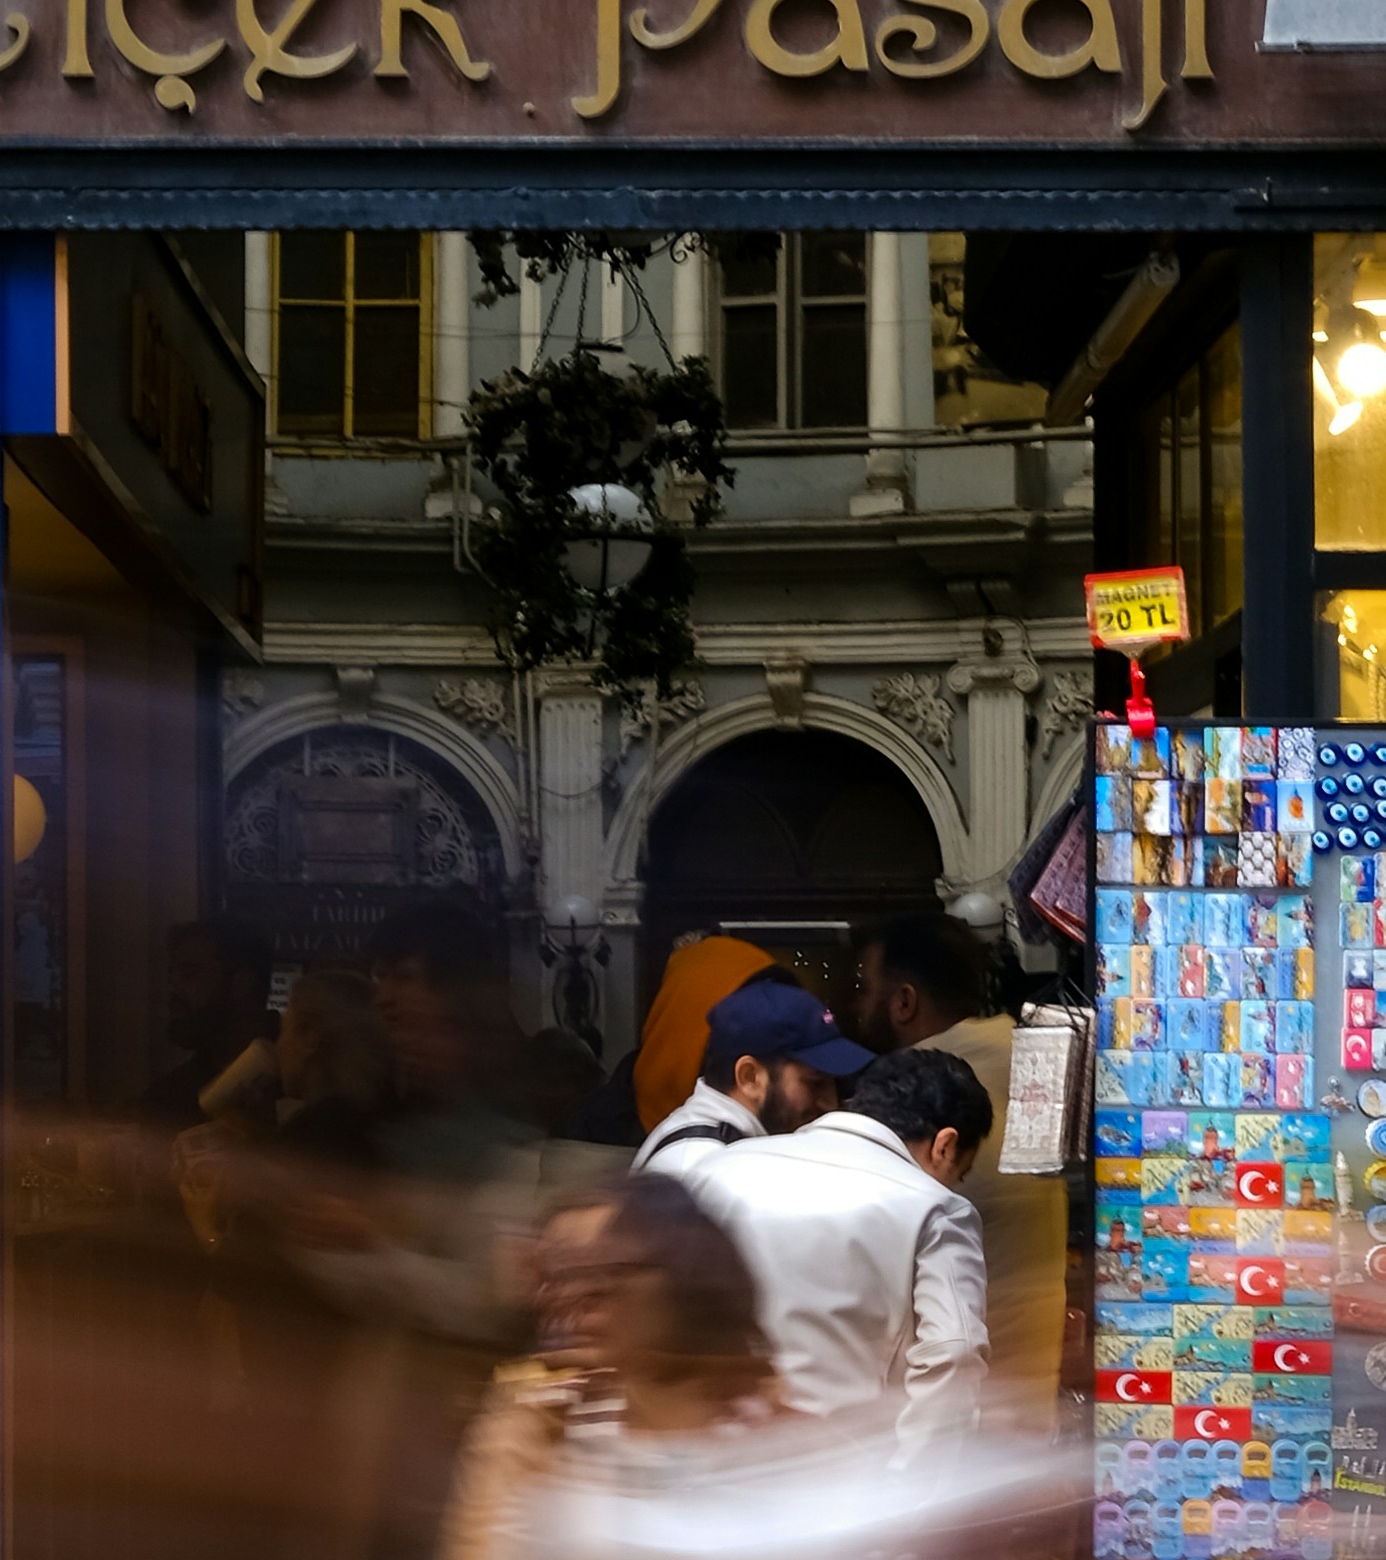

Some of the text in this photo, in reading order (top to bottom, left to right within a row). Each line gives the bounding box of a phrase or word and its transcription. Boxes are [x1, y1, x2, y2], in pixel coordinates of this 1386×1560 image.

[1097, 584, 1170, 604] MAGNET
[1099, 603, 1175, 631] 20 TL
